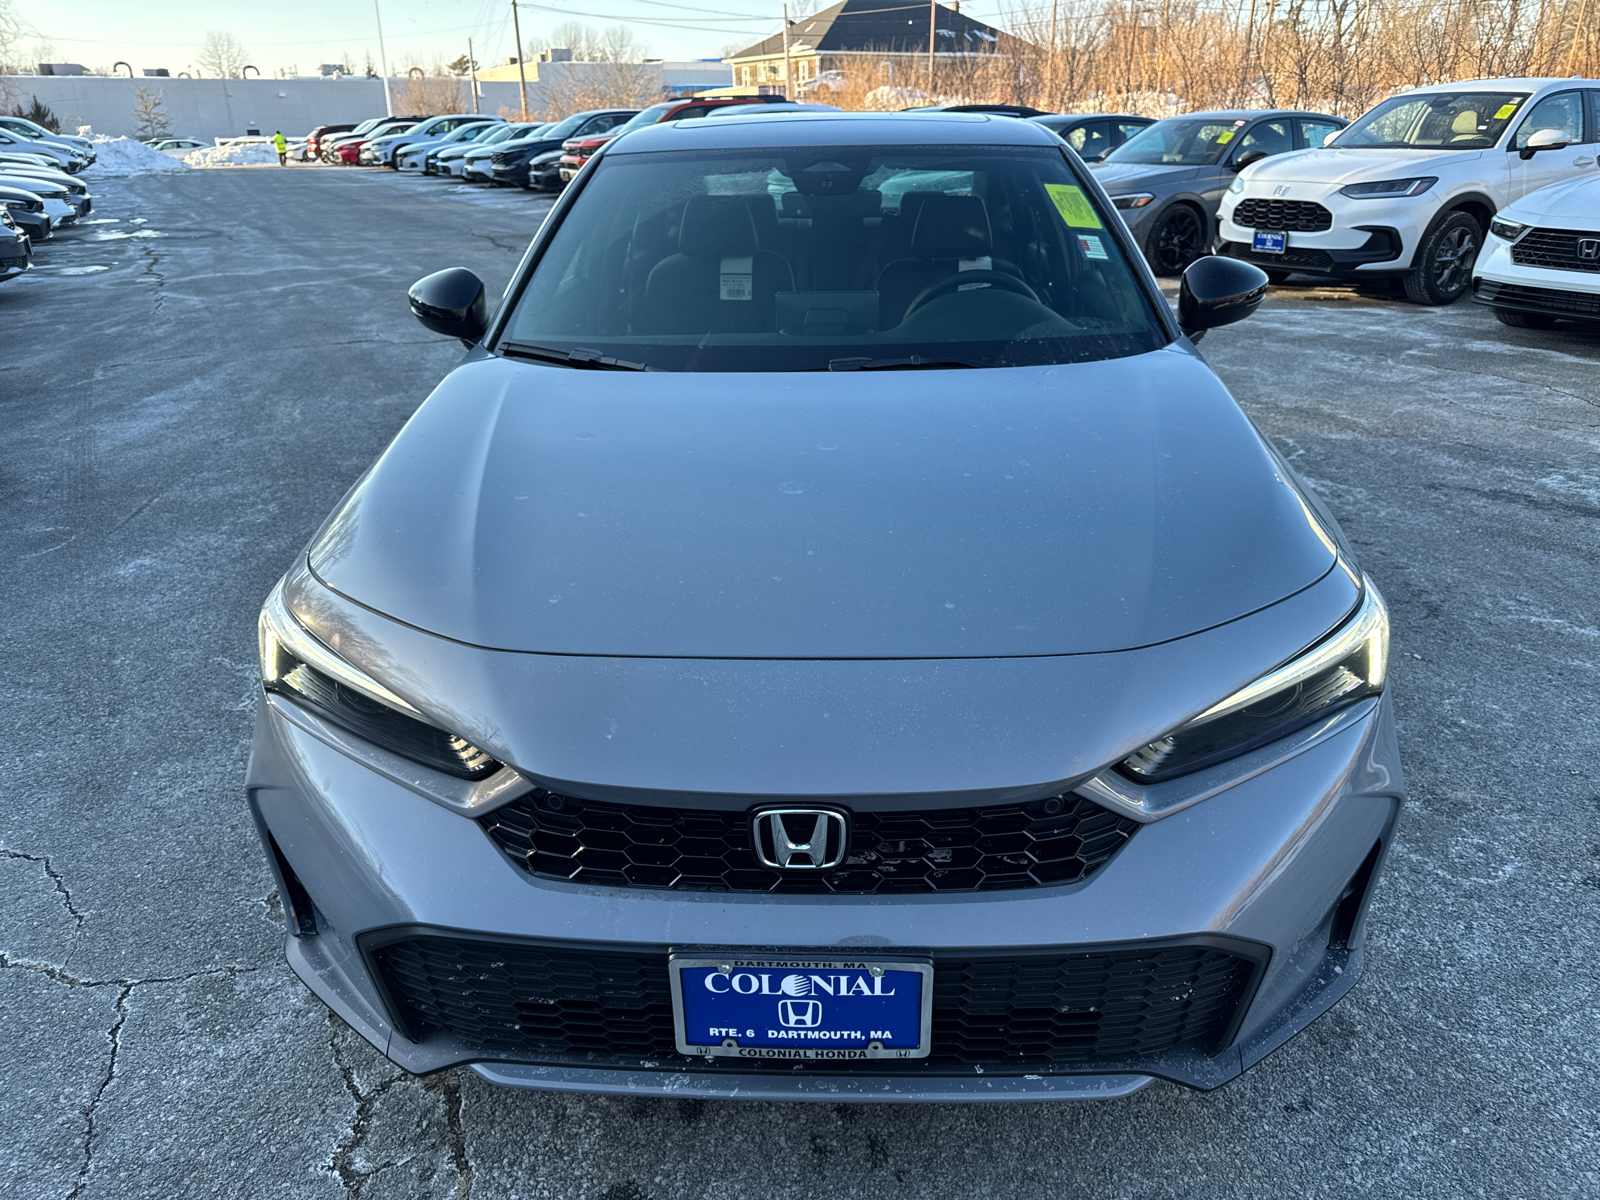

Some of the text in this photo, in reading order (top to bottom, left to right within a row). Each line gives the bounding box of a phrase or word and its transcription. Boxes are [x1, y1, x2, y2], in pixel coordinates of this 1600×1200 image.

[734, 960, 838, 969] DARTMOUTH,
[704, 972, 896, 997] COLONIAL
[709, 1027, 893, 1040] RTE. 6 DARTMOUTH, MA
[738, 1048, 868, 1059] COLONIAL HONDA
